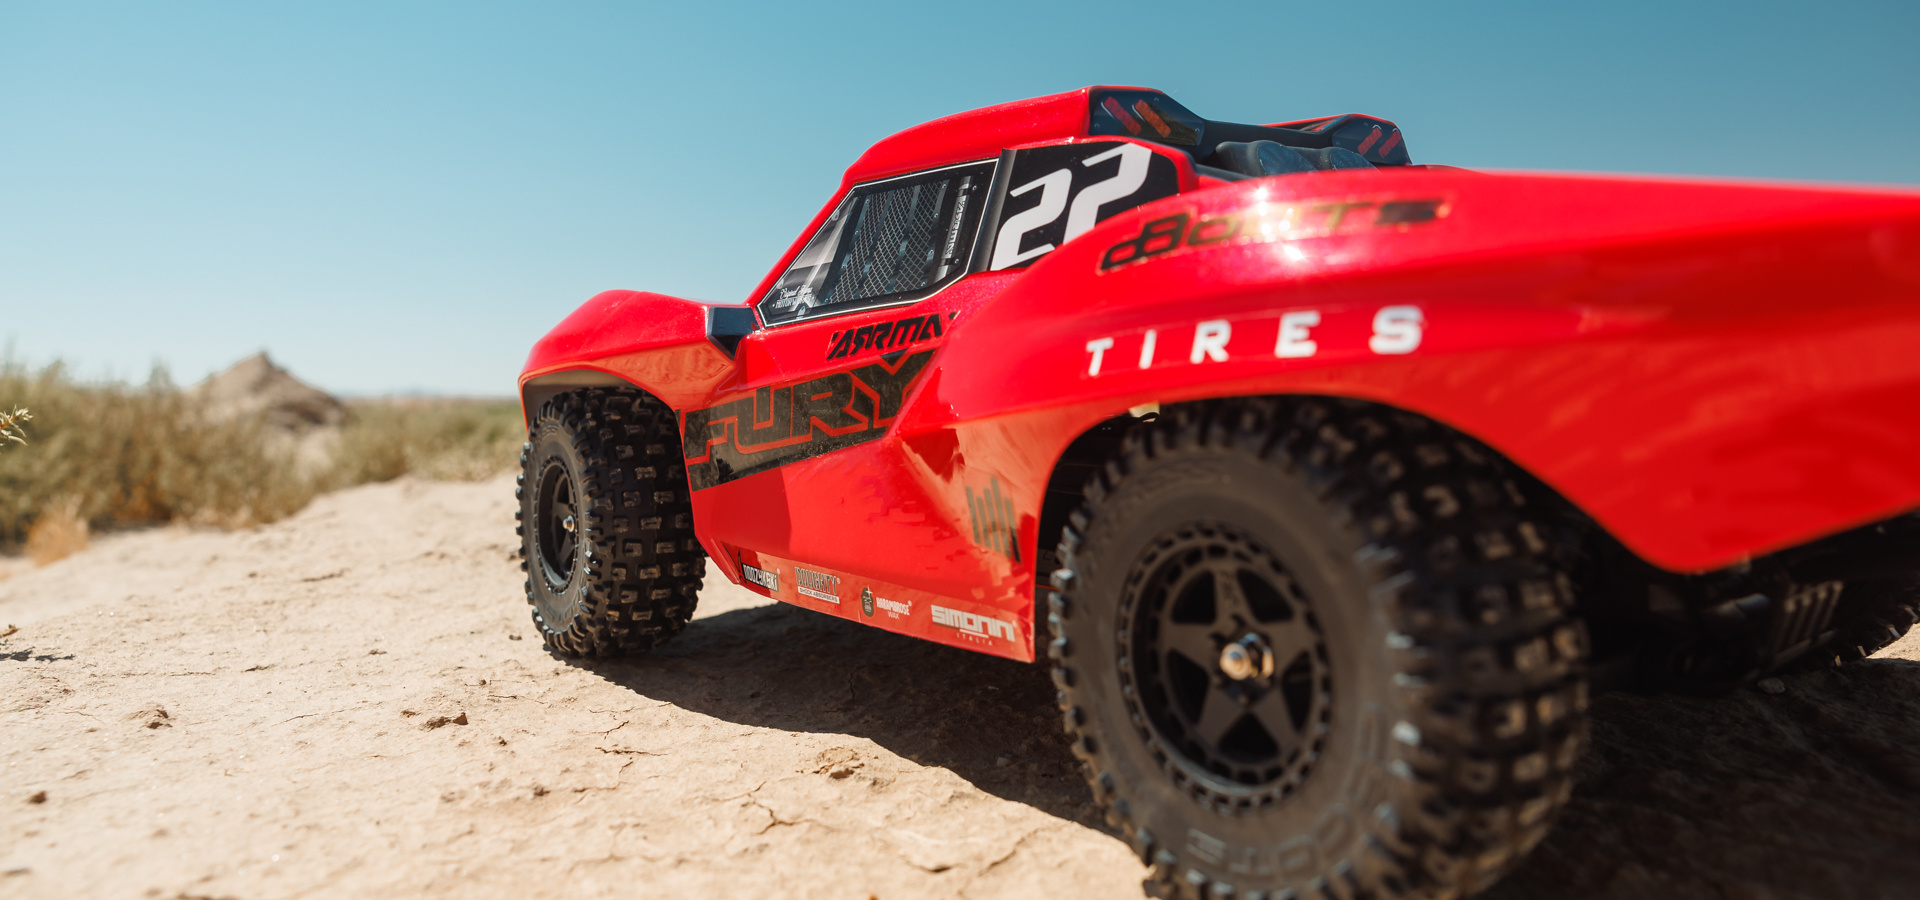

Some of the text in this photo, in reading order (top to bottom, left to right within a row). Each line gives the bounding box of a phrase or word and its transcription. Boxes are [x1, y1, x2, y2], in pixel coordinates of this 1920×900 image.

[990, 143, 1152, 270] 22
[1086, 305, 1425, 377] TIRES
[684, 349, 937, 462] FURY
[957, 633, 994, 647] ITALIA
